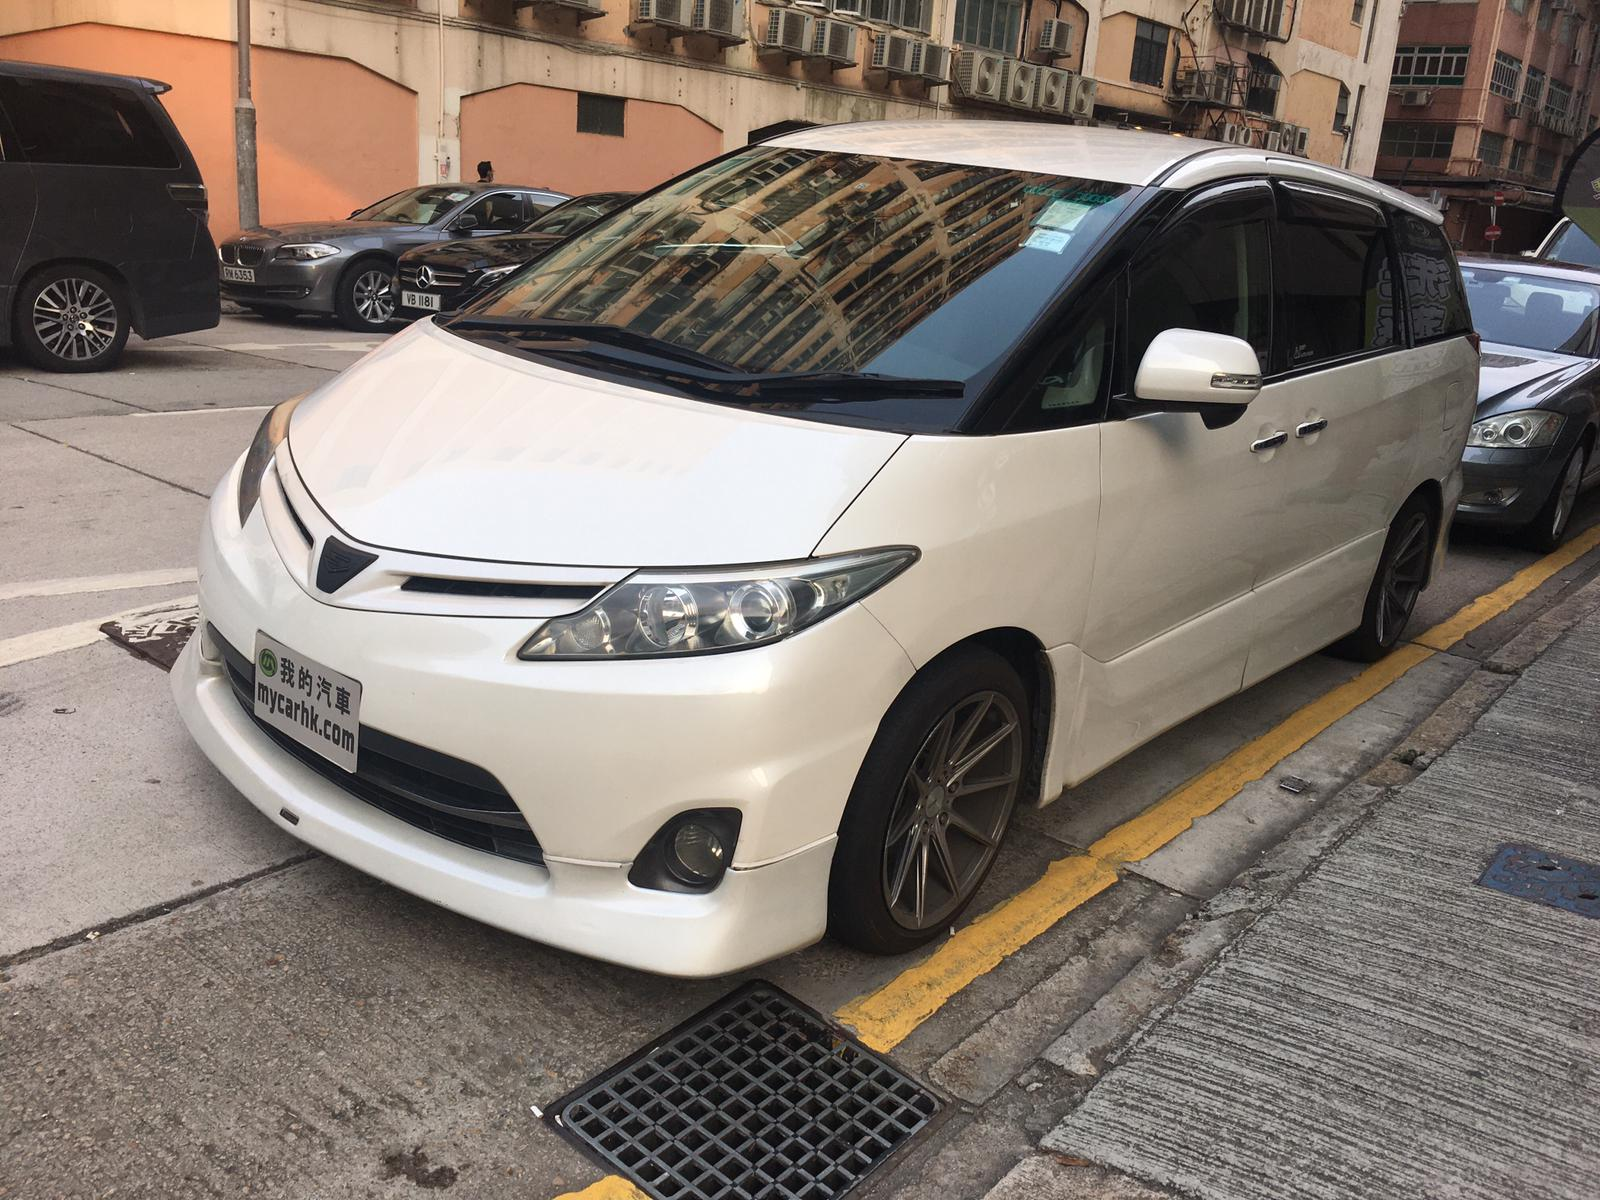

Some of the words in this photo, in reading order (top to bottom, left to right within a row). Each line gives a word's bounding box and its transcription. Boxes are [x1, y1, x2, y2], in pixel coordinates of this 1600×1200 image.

[234, 269, 253, 281] 6353
[406, 293, 416, 305] VB
[418, 295, 434, 308] 1181
[280, 657, 351, 716] 我的汽車
[257, 681, 355, 754] mycarhk.com
